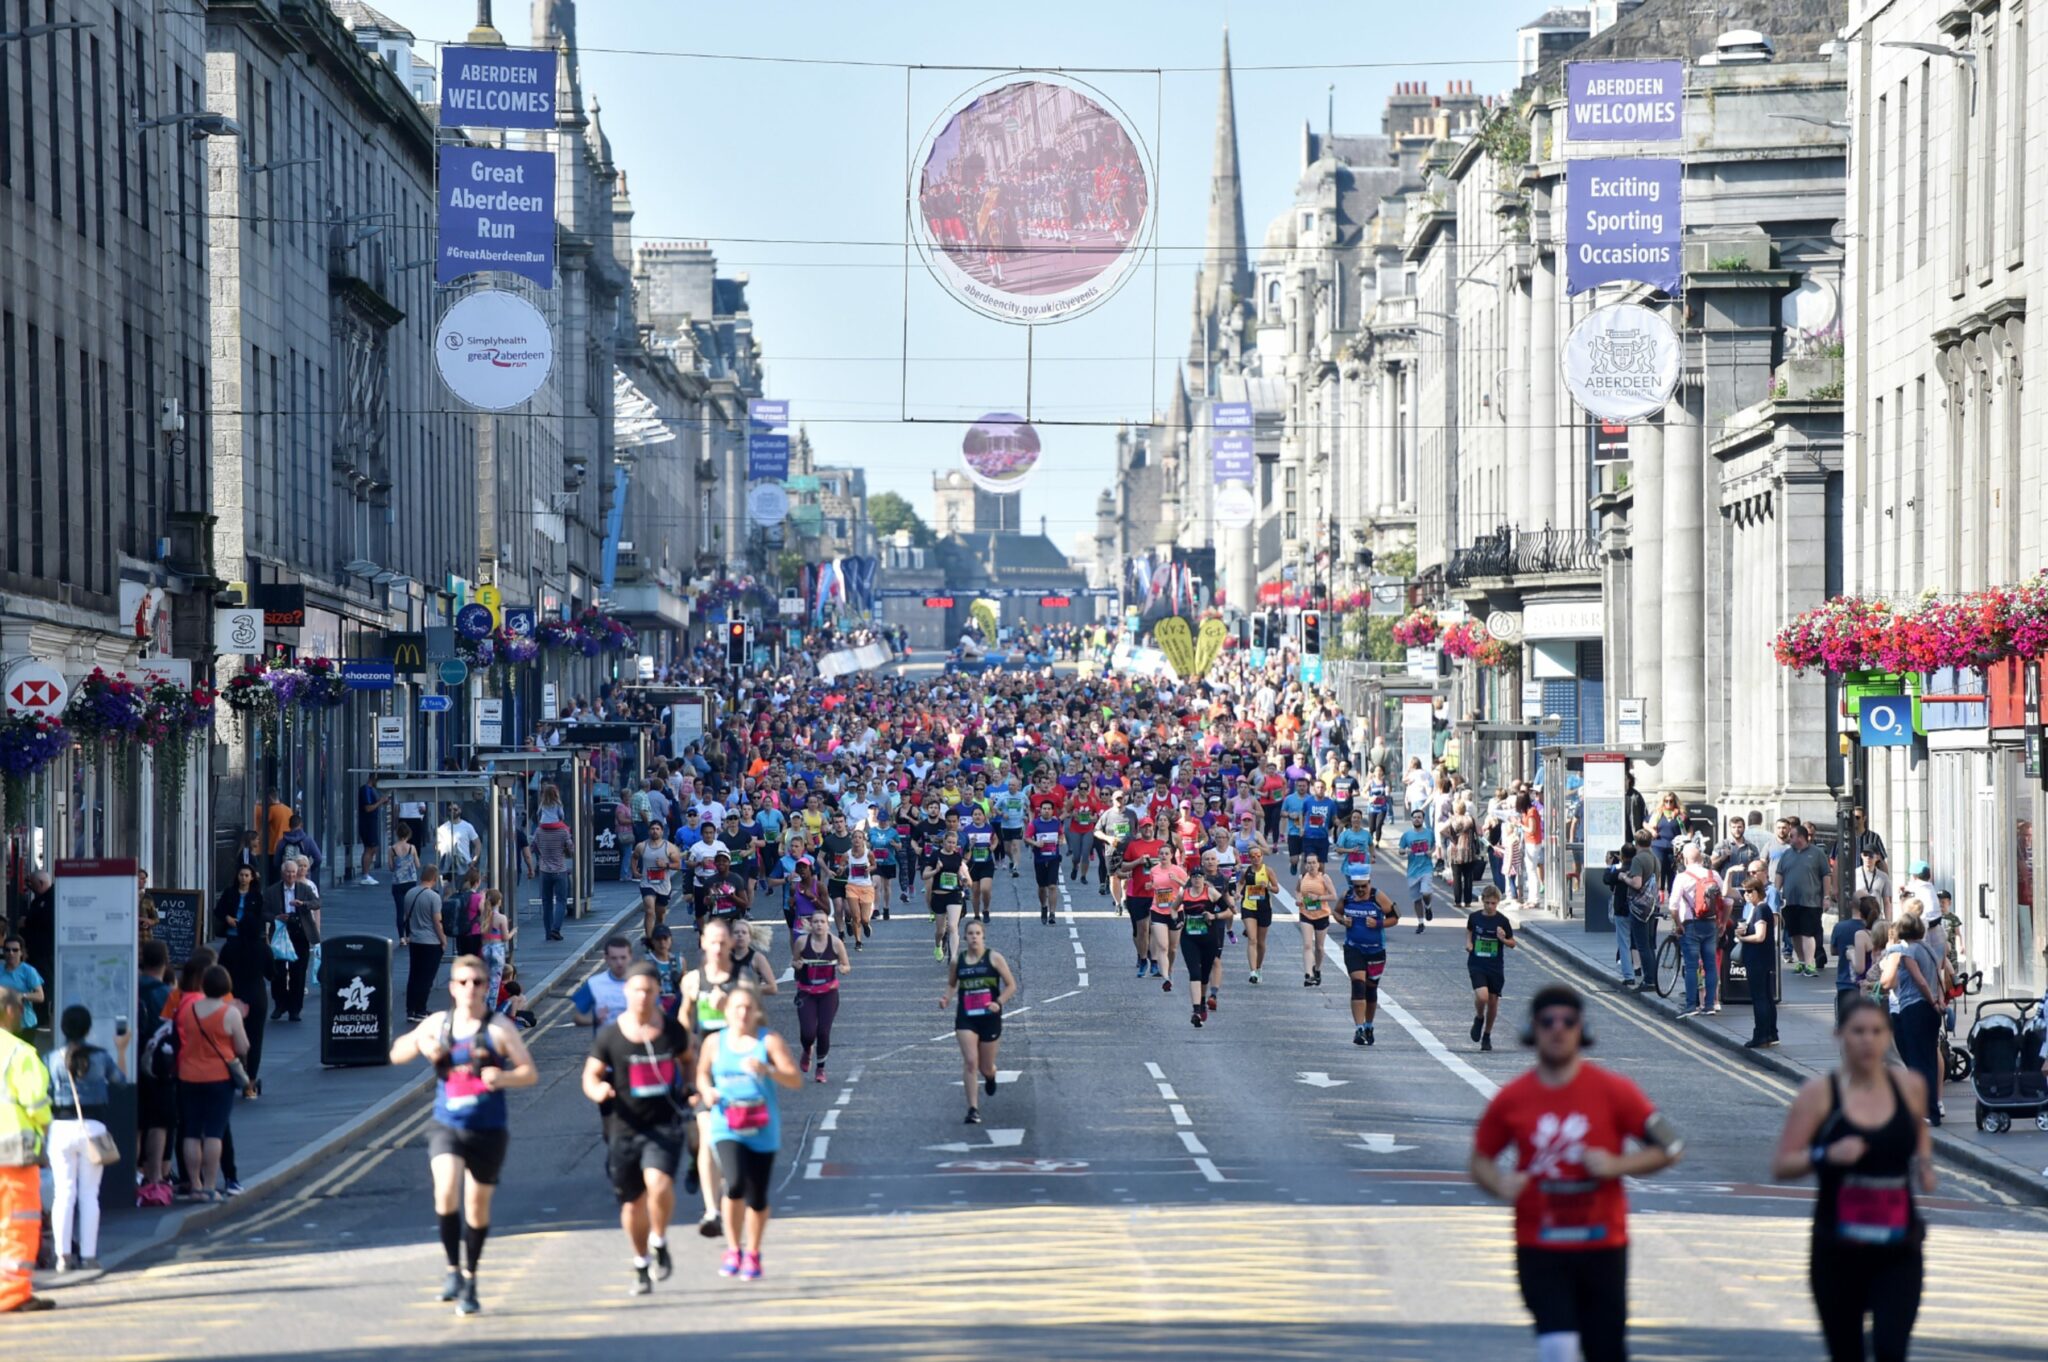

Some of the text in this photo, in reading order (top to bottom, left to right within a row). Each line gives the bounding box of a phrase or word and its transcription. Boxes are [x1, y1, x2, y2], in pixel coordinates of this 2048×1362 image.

[461, 64, 537, 84] ABERDEEN
[1586, 78, 1663, 95] ABERDEEN
[449, 88, 549, 112] WELCOMES
[1575, 102, 1675, 124] WELCOMES
[471, 161, 524, 183] Great
[1590, 177, 1660, 201] Exciting
[450, 187, 543, 212] Aberdeen
[478, 217, 515, 239] Run
[1586, 210, 1663, 234] Sporting
[446, 246, 545, 263] #GreatAberdeenRun
[1579, 244, 1670, 263] Occasions
[964, 284, 1099, 316] aberdeencity.gov.uk/cityevents
[467, 336, 527, 346] Simplyhealth
[467, 350, 544, 362] great aberdeen
[1585, 376, 1662, 388] ABERDEEN
[1593, 389, 1654, 397] CITY COUNCIL
[264, 609, 303, 624] size?
[345, 671, 391, 680] shoezone
[161, 900, 186, 908] AVO
[332, 1021, 379, 1036] inspired
